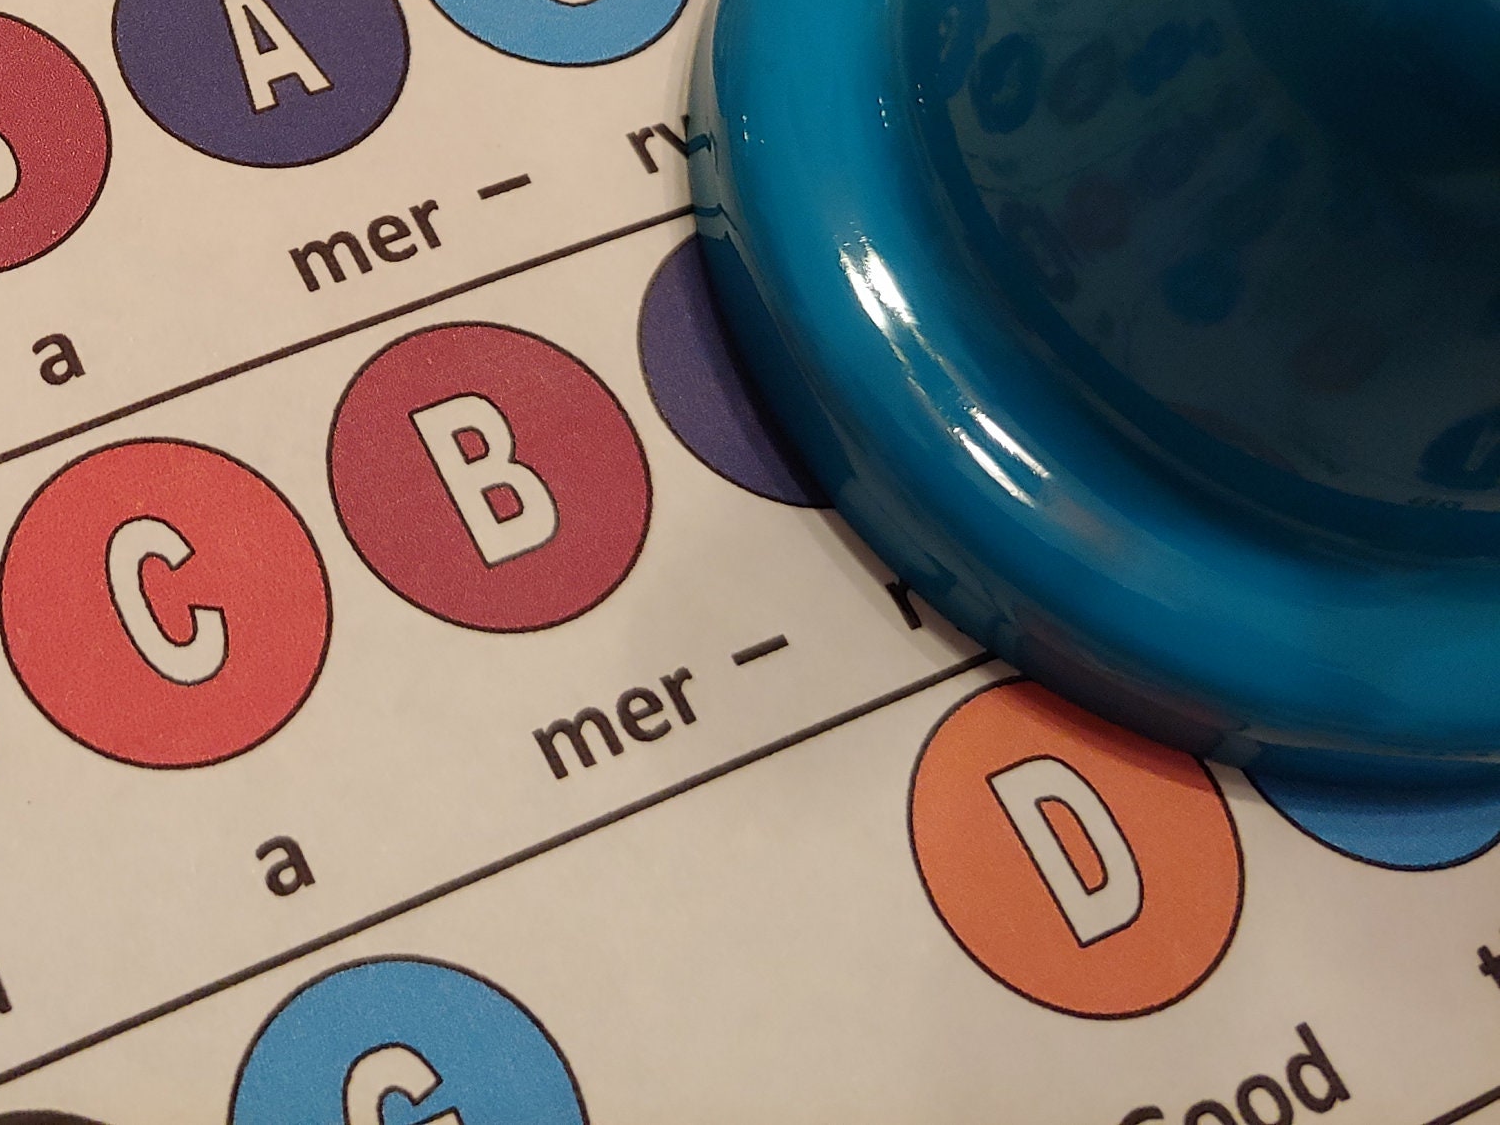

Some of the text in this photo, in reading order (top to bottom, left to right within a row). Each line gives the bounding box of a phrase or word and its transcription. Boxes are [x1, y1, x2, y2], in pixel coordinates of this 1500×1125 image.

[31, 332, 87, 386] a
[288, 197, 443, 293] mer
[104, 515, 230, 687] C
[407, 391, 561, 570] B
[255, 834, 316, 897] a
[532, 666, 699, 780] mer
[985, 755, 1144, 949] D
[1117, 1021, 1351, 1125] od
